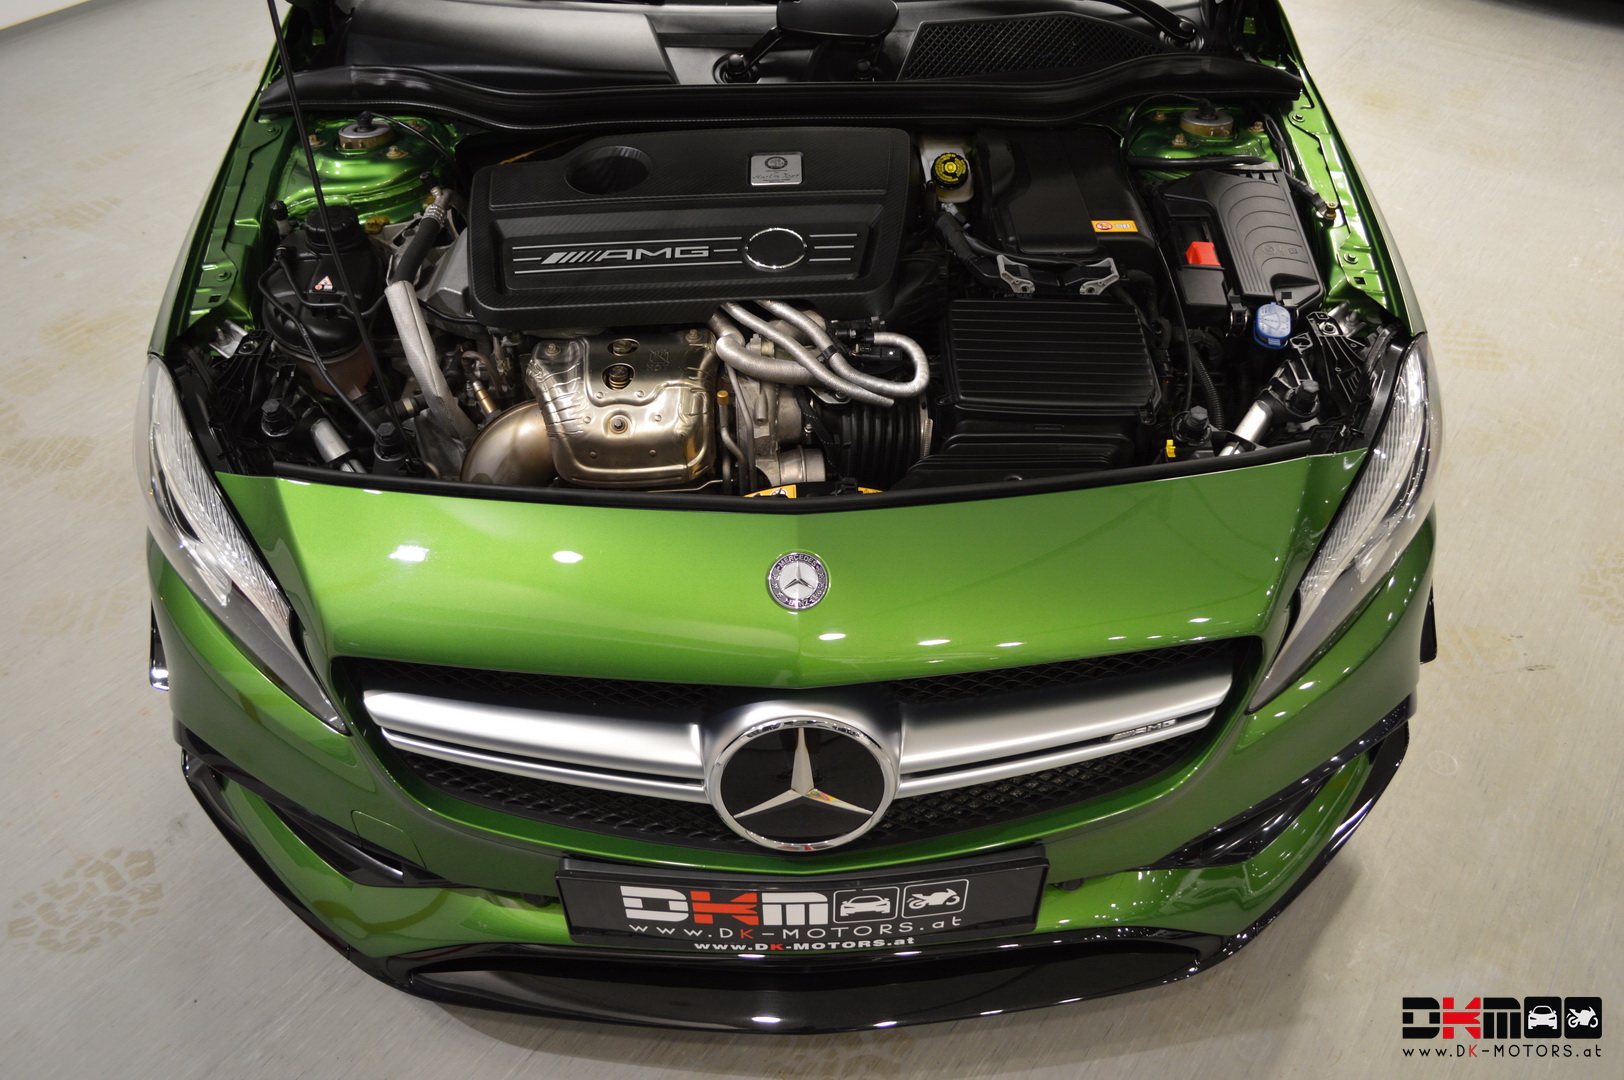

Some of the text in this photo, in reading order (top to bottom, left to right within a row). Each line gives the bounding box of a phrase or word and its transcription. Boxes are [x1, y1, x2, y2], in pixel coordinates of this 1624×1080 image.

[594, 246, 709, 262] AMG
[628, 916, 962, 939] www.DK-MOTORS.at
[693, 936, 915, 951] www.DK-MOTORS.at
